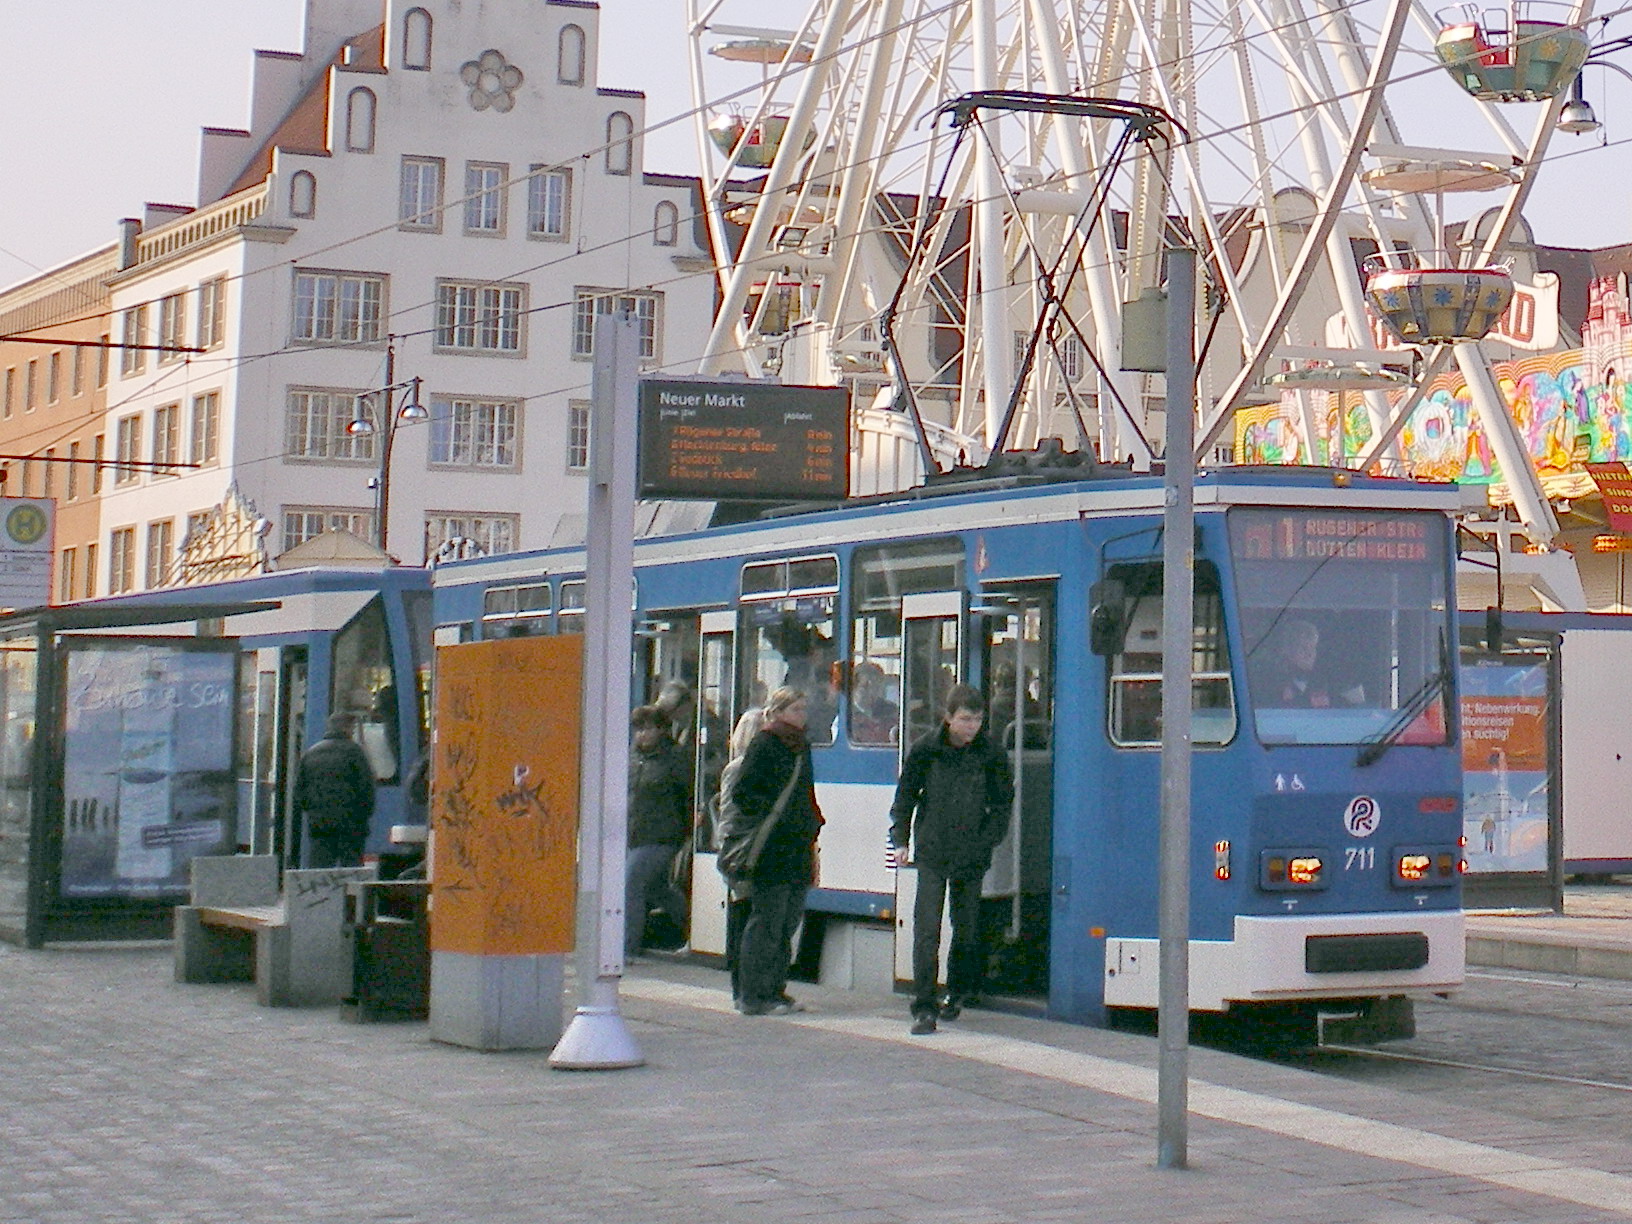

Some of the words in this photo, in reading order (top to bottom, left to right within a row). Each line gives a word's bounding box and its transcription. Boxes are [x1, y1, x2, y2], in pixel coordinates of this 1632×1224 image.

[660, 392, 701, 406] Neuer
[705, 394, 745, 408] Markt
[1343, 846, 1376, 872] 711
